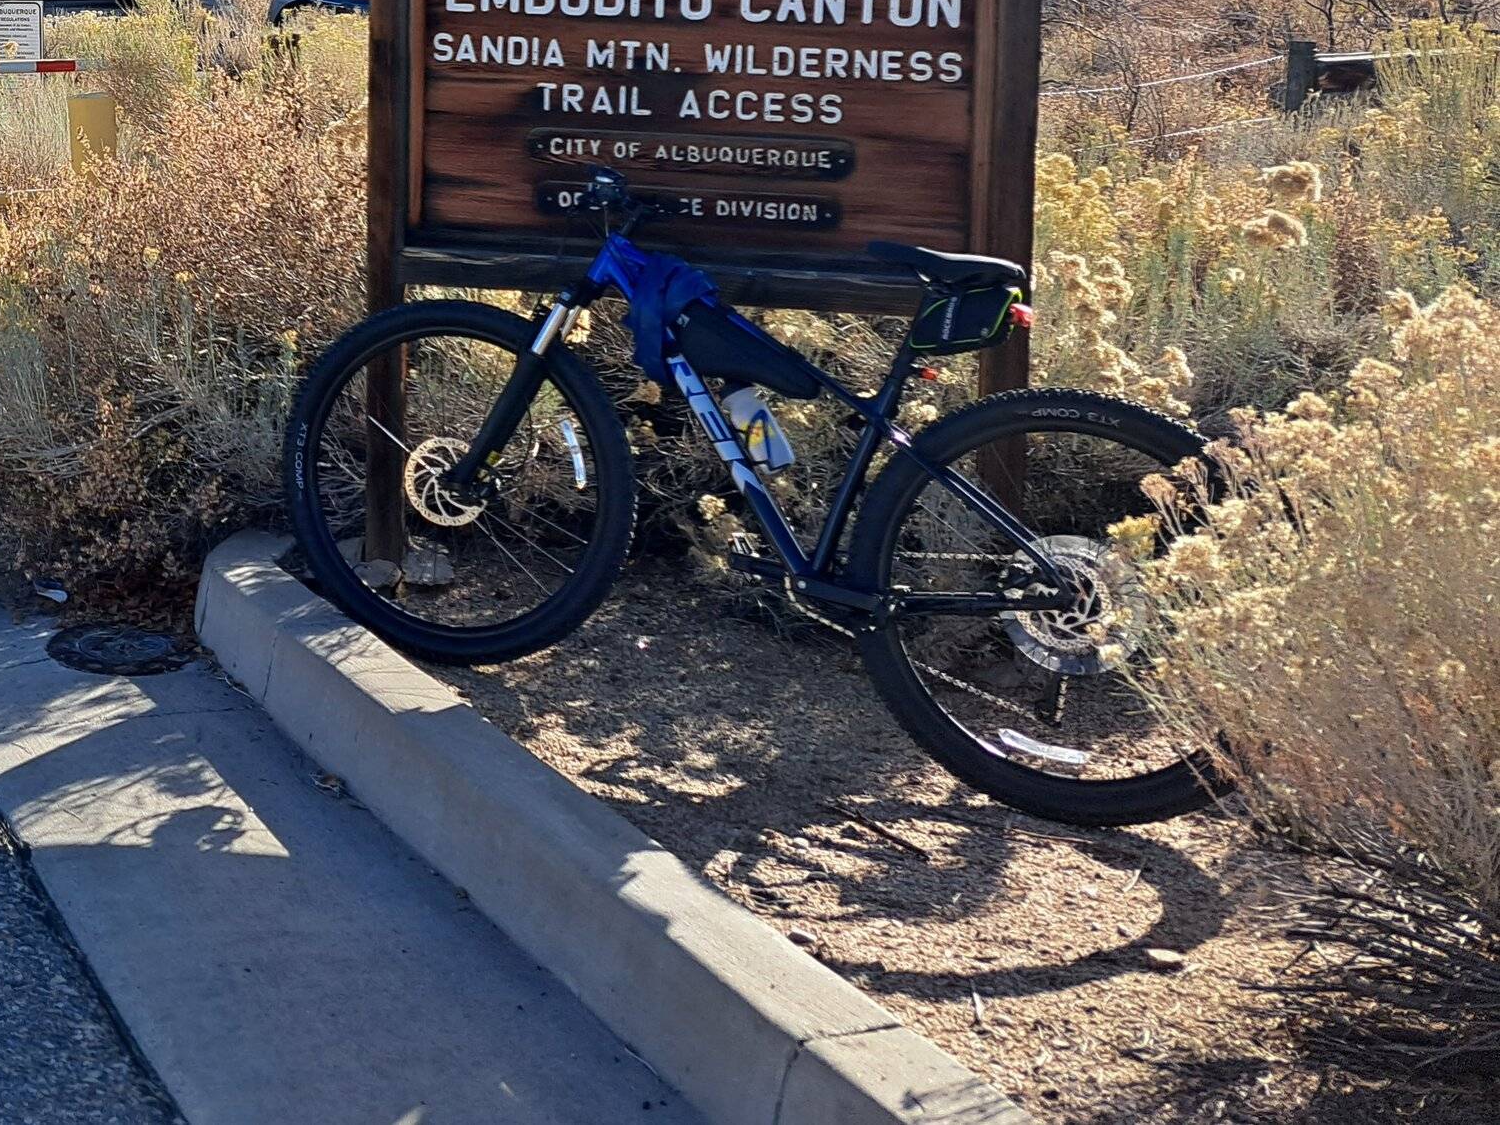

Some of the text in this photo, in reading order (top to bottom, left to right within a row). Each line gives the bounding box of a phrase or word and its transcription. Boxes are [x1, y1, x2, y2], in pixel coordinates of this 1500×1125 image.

[433, 32, 963, 83] SANDIA MTN. WILDERNESS
[537, 82, 842, 124] TRAIL ACCESS
[550, 137, 832, 169] CITY OF ALBUQUERQUE
[715, 199, 818, 221] DIVISION
[1031, 408, 1080, 418] COMP
[295, 452, 304, 489] COMP
